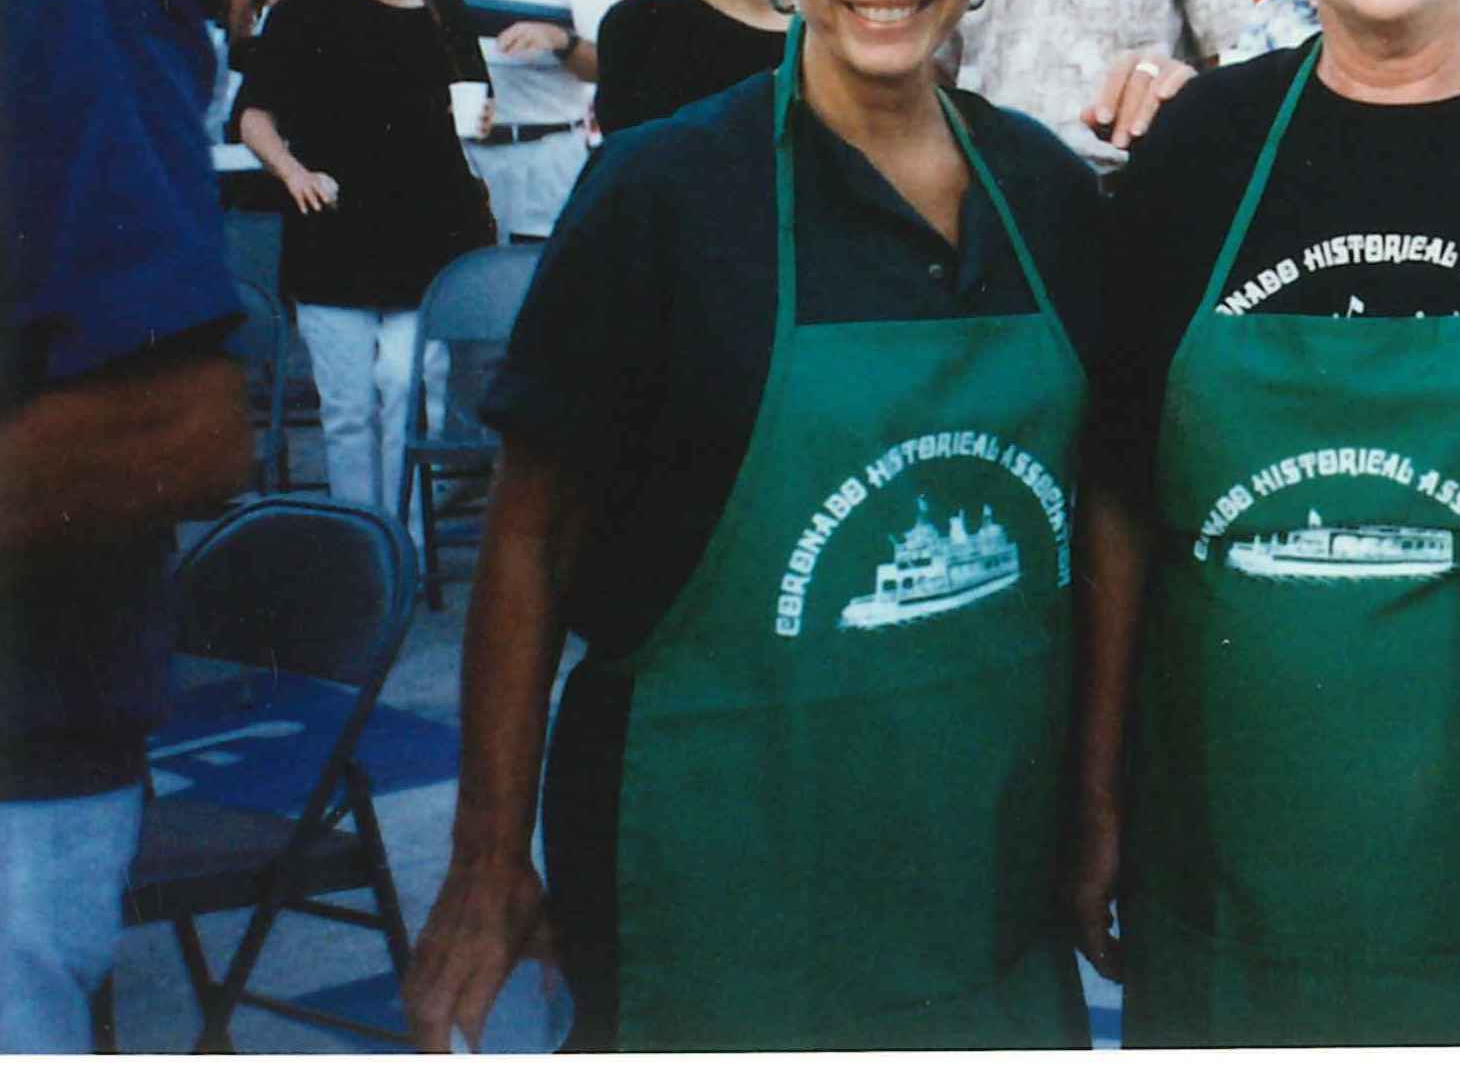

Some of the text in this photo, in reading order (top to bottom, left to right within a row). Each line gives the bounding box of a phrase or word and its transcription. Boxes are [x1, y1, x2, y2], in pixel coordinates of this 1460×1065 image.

[1303, 234, 1458, 272] HISTORICAL
[1252, 448, 1415, 496] HISTORICAL
[774, 476, 868, 637] CORONADO
[865, 431, 999, 488] HISTORICAL
